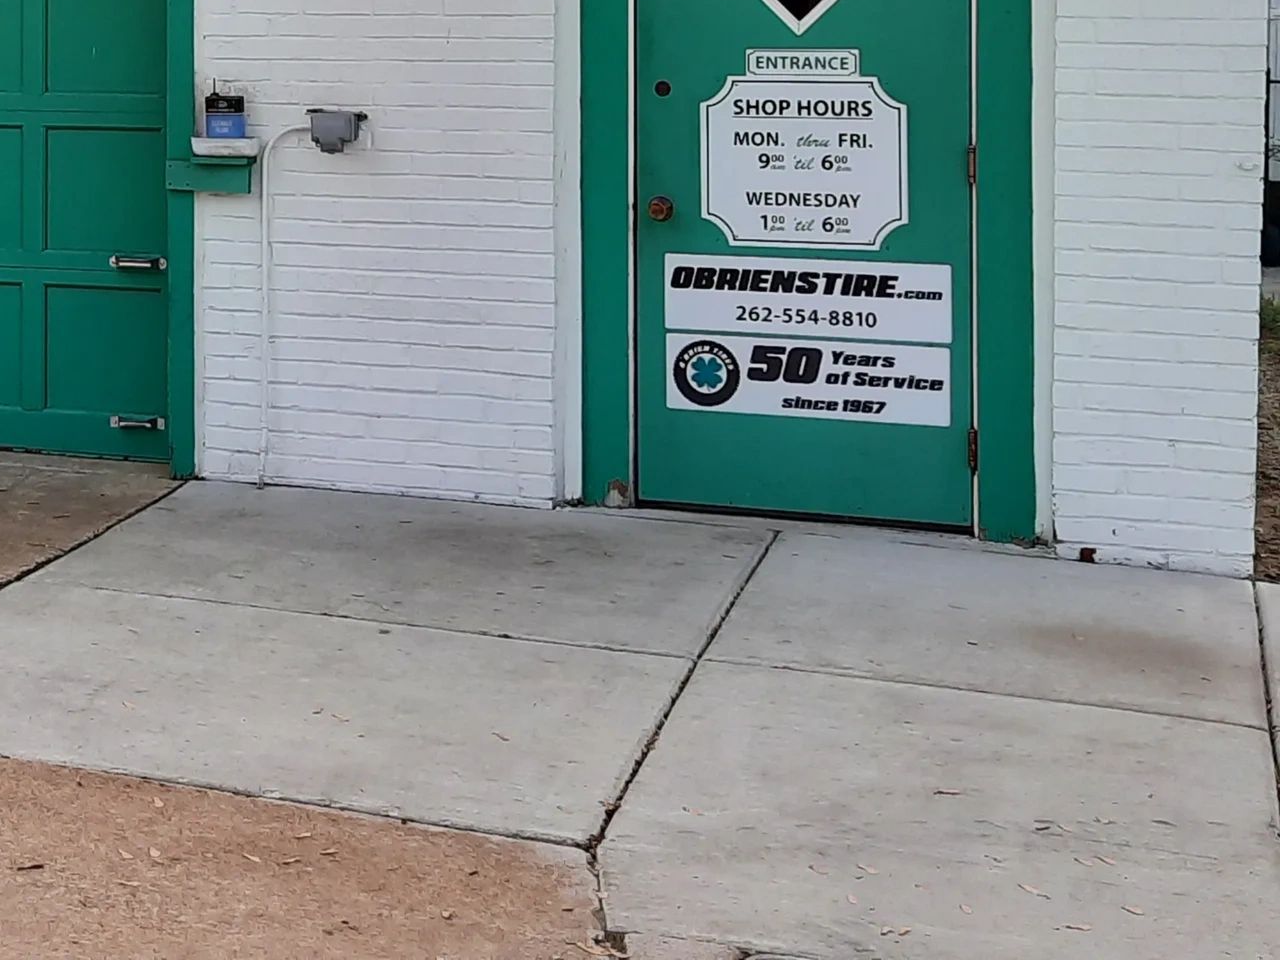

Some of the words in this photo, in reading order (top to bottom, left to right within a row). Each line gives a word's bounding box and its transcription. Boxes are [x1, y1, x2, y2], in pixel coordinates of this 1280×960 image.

[755, 56, 850, 71] ENTRANCE
[732, 99, 791, 116] SHOP
[796, 100, 874, 118] HOURS
[733, 131, 785, 147] MON.
[795, 133, 831, 148] thru
[837, 133, 873, 149] FRI.
[745, 191, 861, 208] WEDNESDAY
[670, 265, 943, 301] OBRIENSTIRE.com
[735, 305, 878, 328] 262-554-8810
[746, 344, 823, 384] 50
[830, 350, 896, 368] Years
[825, 372, 848, 386] of
[853, 372, 944, 392] Service
[781, 396, 839, 412] since
[842, 399, 887, 415] 1967
